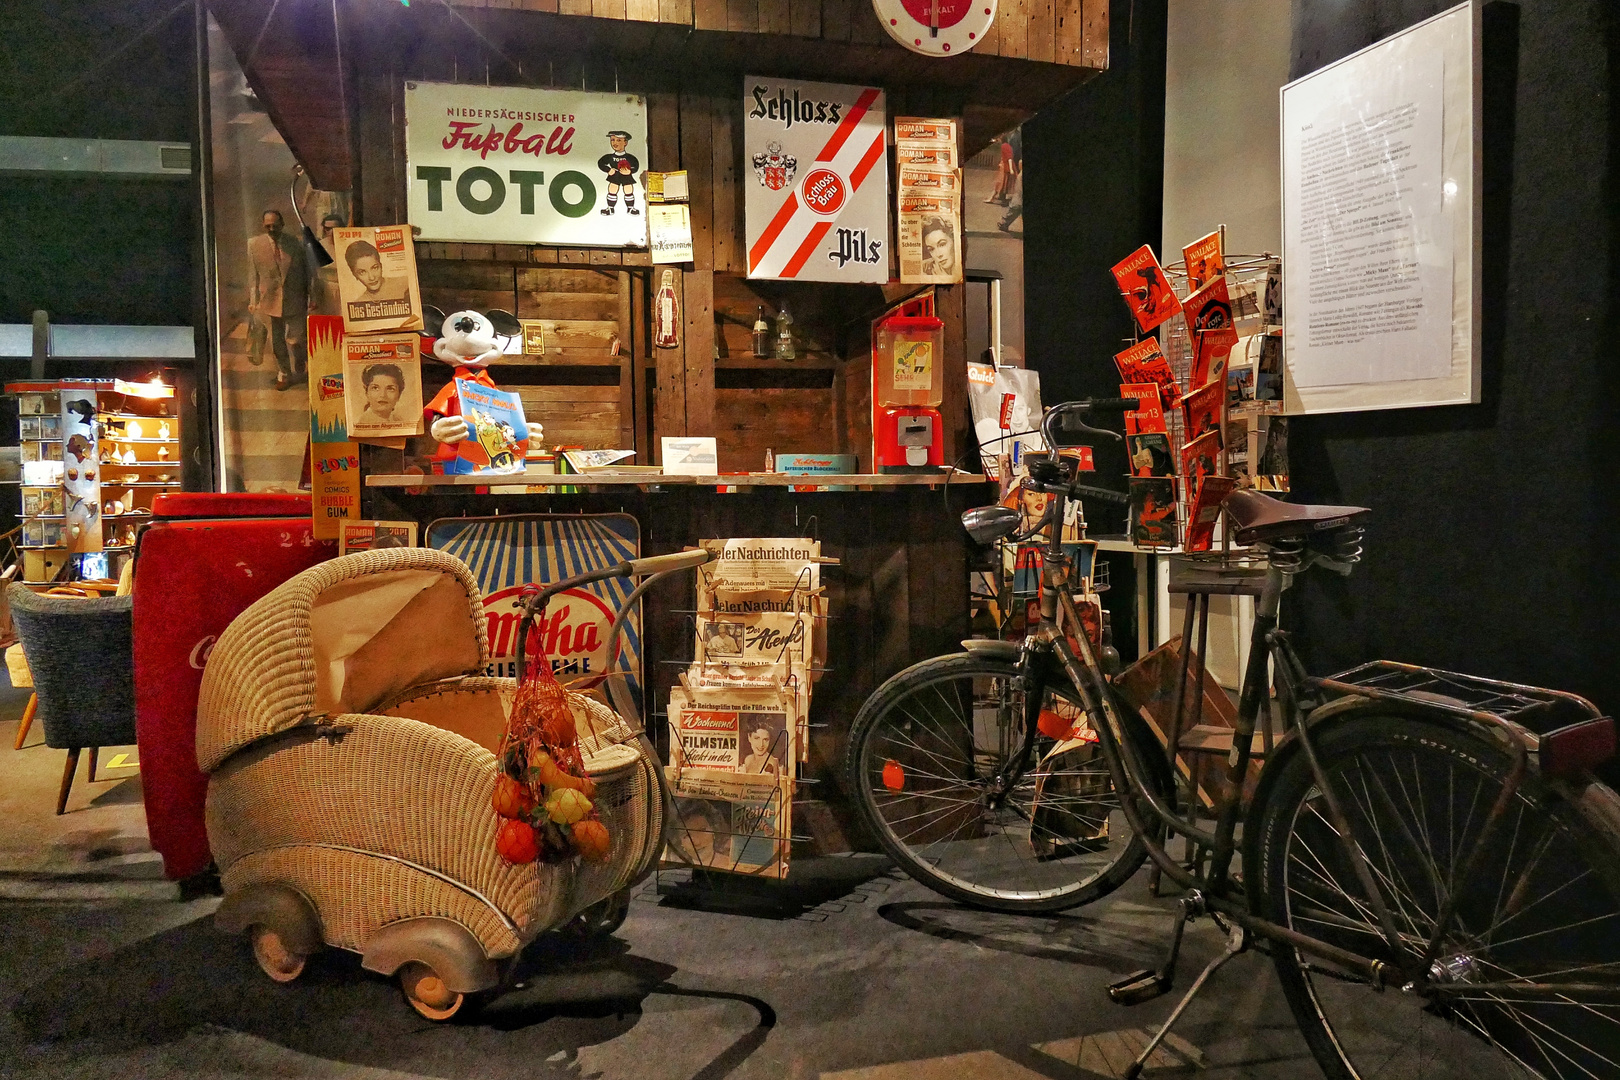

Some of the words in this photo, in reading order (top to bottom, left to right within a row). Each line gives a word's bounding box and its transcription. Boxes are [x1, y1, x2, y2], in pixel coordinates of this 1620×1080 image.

[447, 107, 575, 123] NIEDERSÄCHSISCHER
[750, 85, 842, 129] Schloss
[898, 124, 925, 133] ROMAN
[442, 121, 576, 160] Fußball
[416, 165, 597, 218] TOTO
[806, 174, 834, 204] Schloss
[818, 185, 838, 206] Bräu
[376, 231, 401, 240] ROMAN
[828, 227, 882, 268] Pils
[1190, 240, 1216, 260] WALLACE
[1116, 252, 1150, 278] WALLACE
[349, 304, 365, 318] Das
[366, 301, 410, 317] Geständnis
[1122, 344, 1157, 364] WALLACE
[968, 368, 994, 384] Quick
[1124, 391, 1155, 399] WALLACE
[1149, 408, 1159, 418] 13
[315, 455, 358, 475] PLONG
[320, 496, 354, 506] BUBBLE
[327, 507, 348, 518] GUM
[346, 528, 372, 536] ROMAN
[737, 547, 810, 560] Nachrichten
[682, 712, 736, 729] Wochenend
[683, 736, 736, 750] FILMSTAR
[1263, 818, 1275, 877] MARATHON
